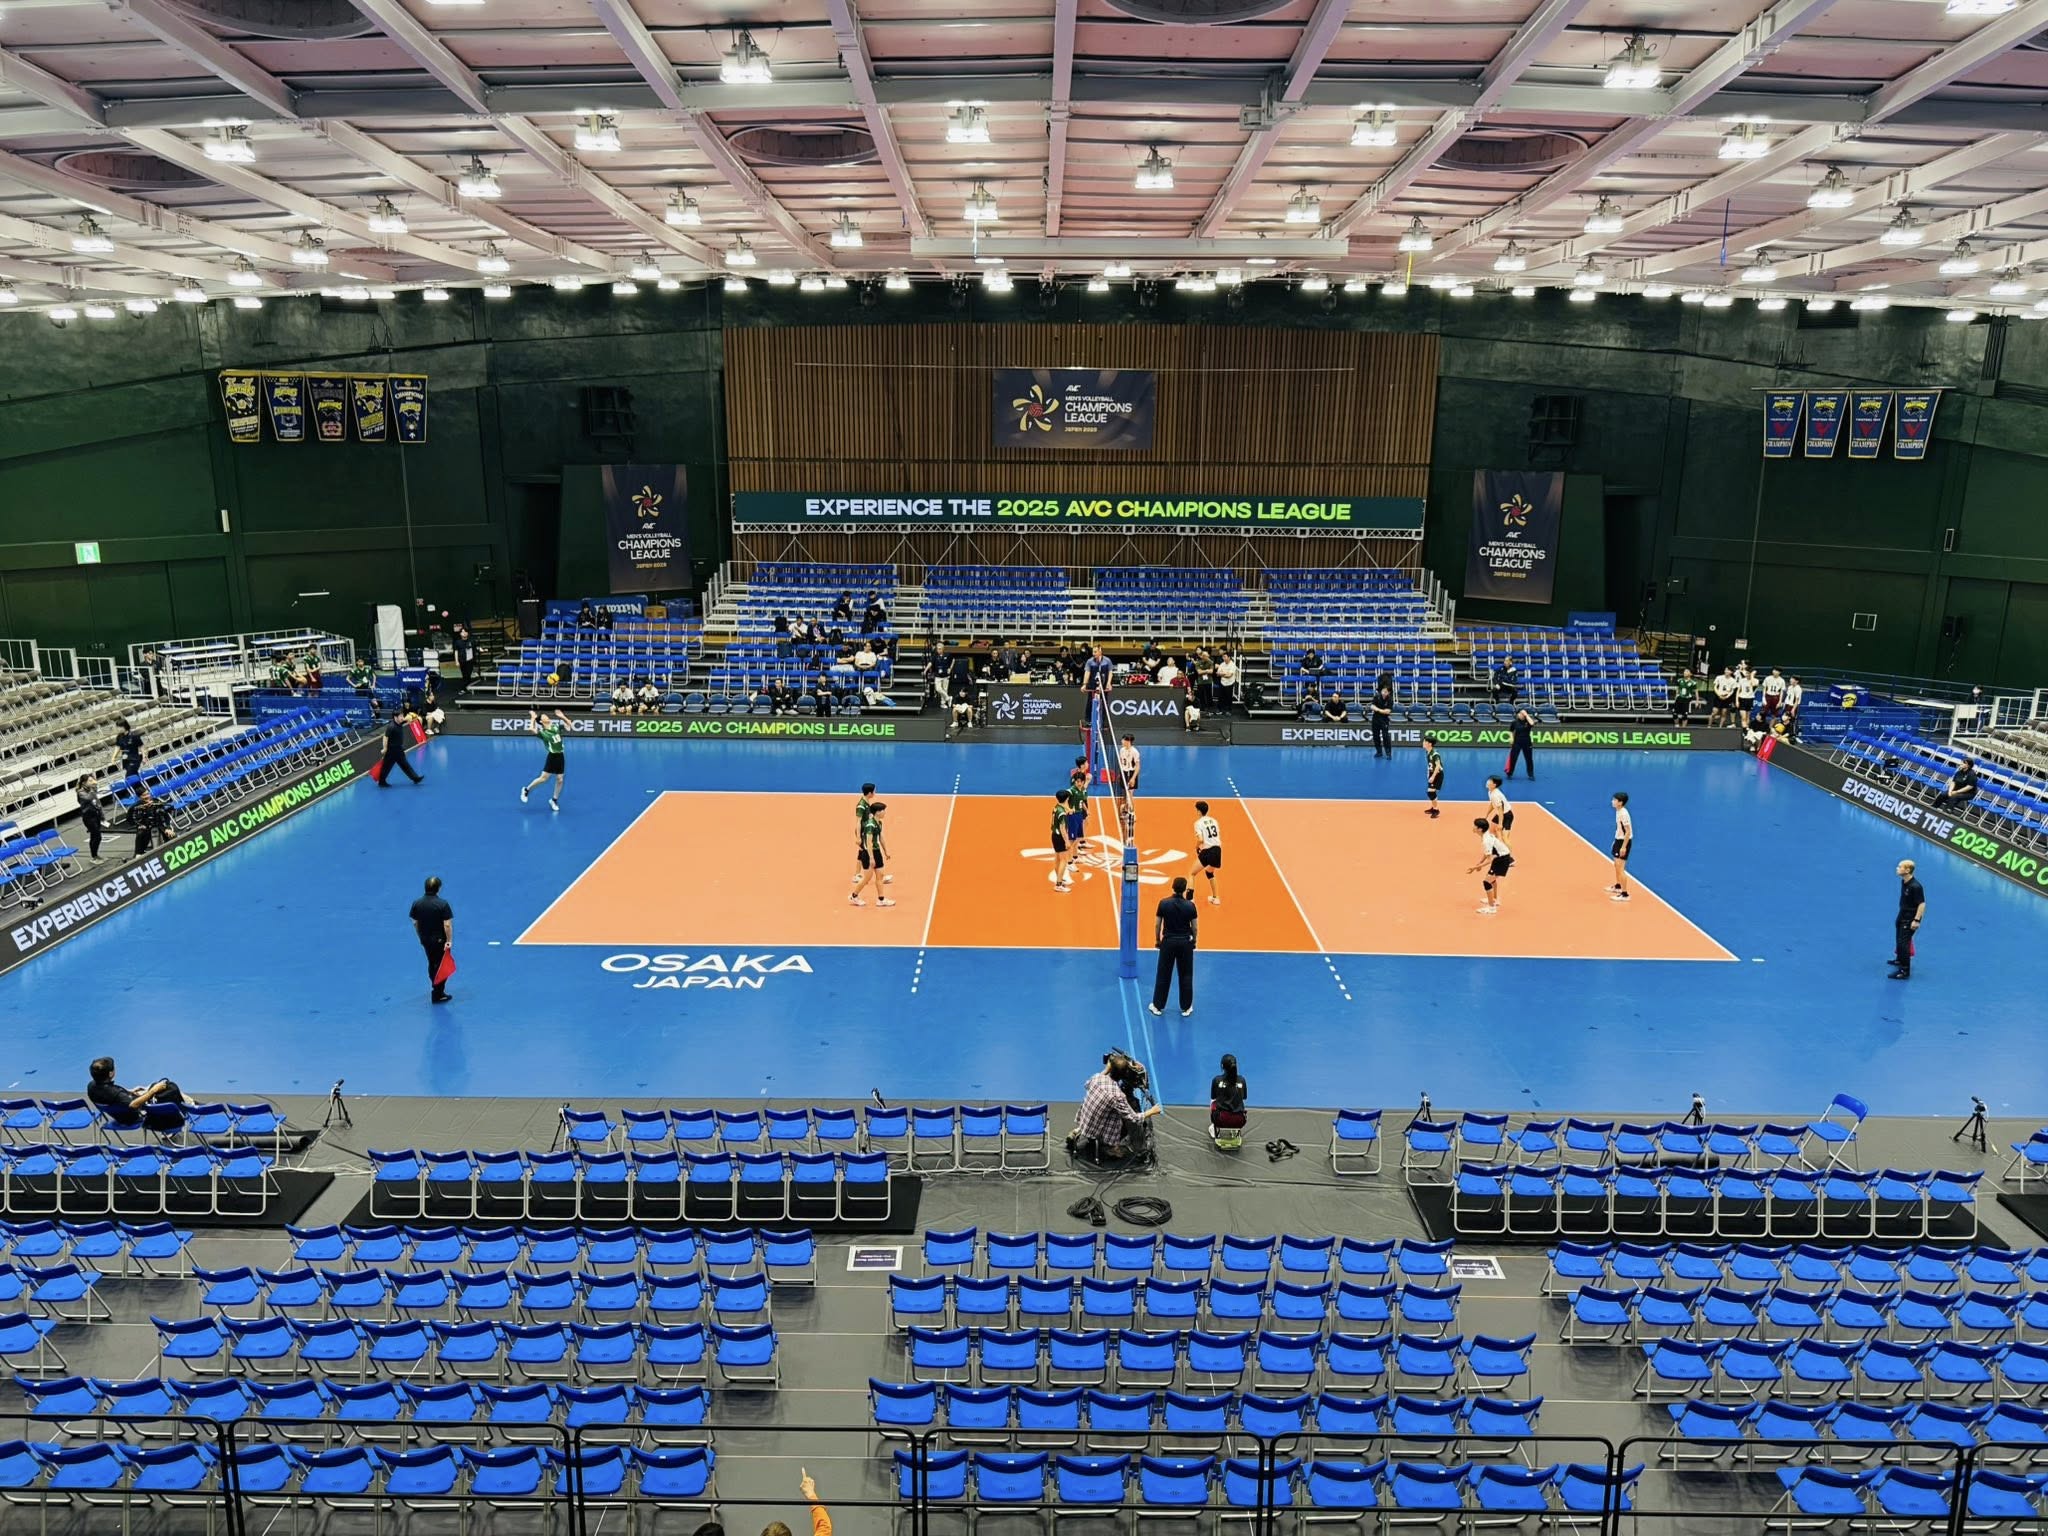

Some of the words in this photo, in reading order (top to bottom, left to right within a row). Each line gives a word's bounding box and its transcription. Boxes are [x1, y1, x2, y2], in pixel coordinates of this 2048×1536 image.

[1065, 402, 1132, 413] CHAMPIONS
[1064, 413, 1107, 423] LEAGUE
[805, 499, 943, 516] EXPERIENCE
[948, 499, 992, 516] THE
[997, 500, 1059, 517] 2025
[1066, 500, 1112, 517] AVC
[1117, 501, 1251, 519] CHAMPIONS
[1258, 503, 1351, 520] LEAGUE
[618, 538, 682, 549] CHAMPIONS
[630, 549, 671, 560] LEAGUE
[1479, 547, 1546, 559] CHAMPIONS
[1489, 558, 1532, 569] LEAGUE
[1110, 700, 1180, 716] OSAKA
[491, 719, 594, 732] EXPECE
[599, 720, 632, 733] THE
[636, 720, 682, 733] 2025
[687, 721, 722, 734] AVC
[726, 722, 825, 735] CHAMPIONS
[829, 723, 895, 736] LEAGUE
[1282, 728, 1383, 741] EXPERIENC
[1388, 729, 1420, 741] THE
[1477, 731, 1513, 743] AVC
[1530, 731, 1619, 744] HAMPIONS
[1623, 732, 1691, 745] LEAGUE
[1206, 825, 1218, 838] 13
[1841, 778, 1922, 825] EXPERIENCE
[1921, 812, 1954, 839] THE
[1951, 828, 1999, 860] 2025
[1996, 850, 2037, 877] AVC
[10, 875, 131, 951] EXPERIENCE
[127, 858, 166, 887] THE
[164, 836, 209, 870] 2025
[210, 820, 240, 847] AVC
[239, 785, 312, 830] CHAMPIONS
[309, 759, 355, 793] LEAGUE
[601, 953, 814, 973] OSAKA
[632, 975, 766, 989] JAPAN
